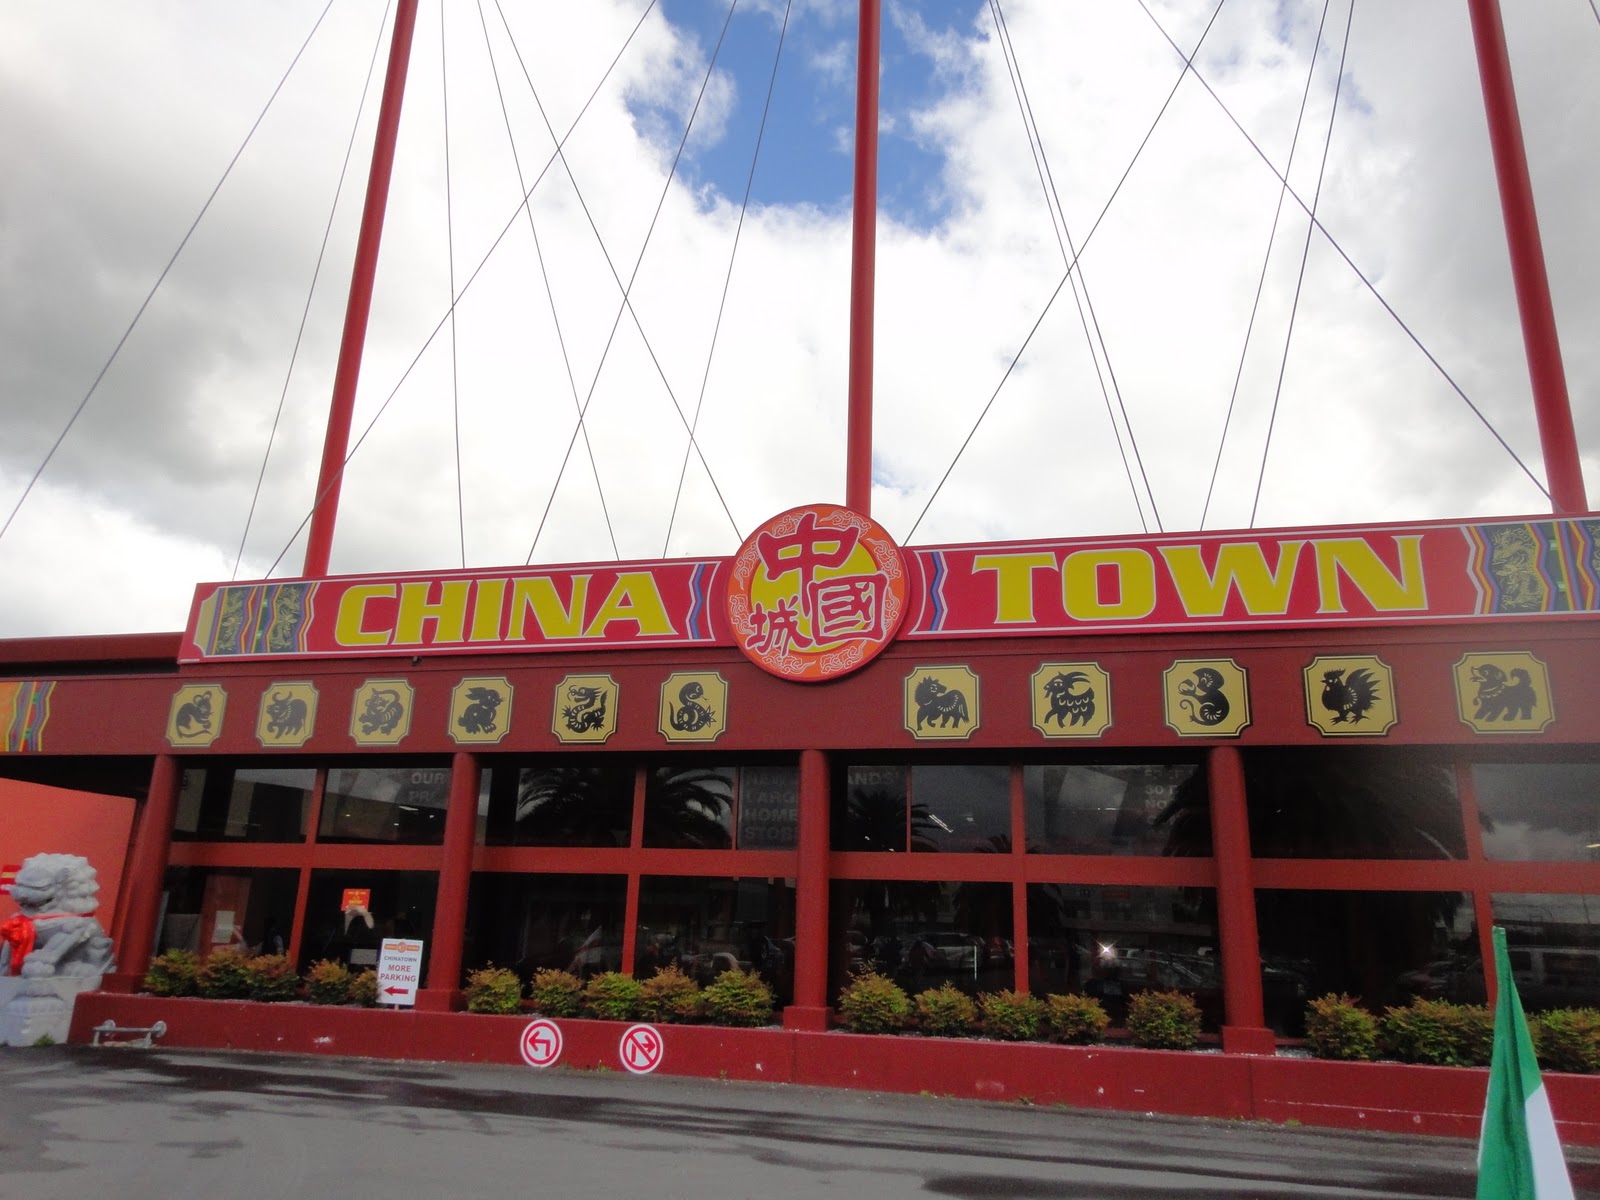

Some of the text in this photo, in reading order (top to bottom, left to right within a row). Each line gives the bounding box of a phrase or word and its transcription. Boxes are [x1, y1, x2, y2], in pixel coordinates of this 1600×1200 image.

[335, 534, 1429, 647] CHINA TOWN
[411, 771, 446, 785] OUR
[383, 955, 418, 963] CHINATOWN
[387, 964, 412, 973] MORE
[380, 972, 417, 983] PARKING
